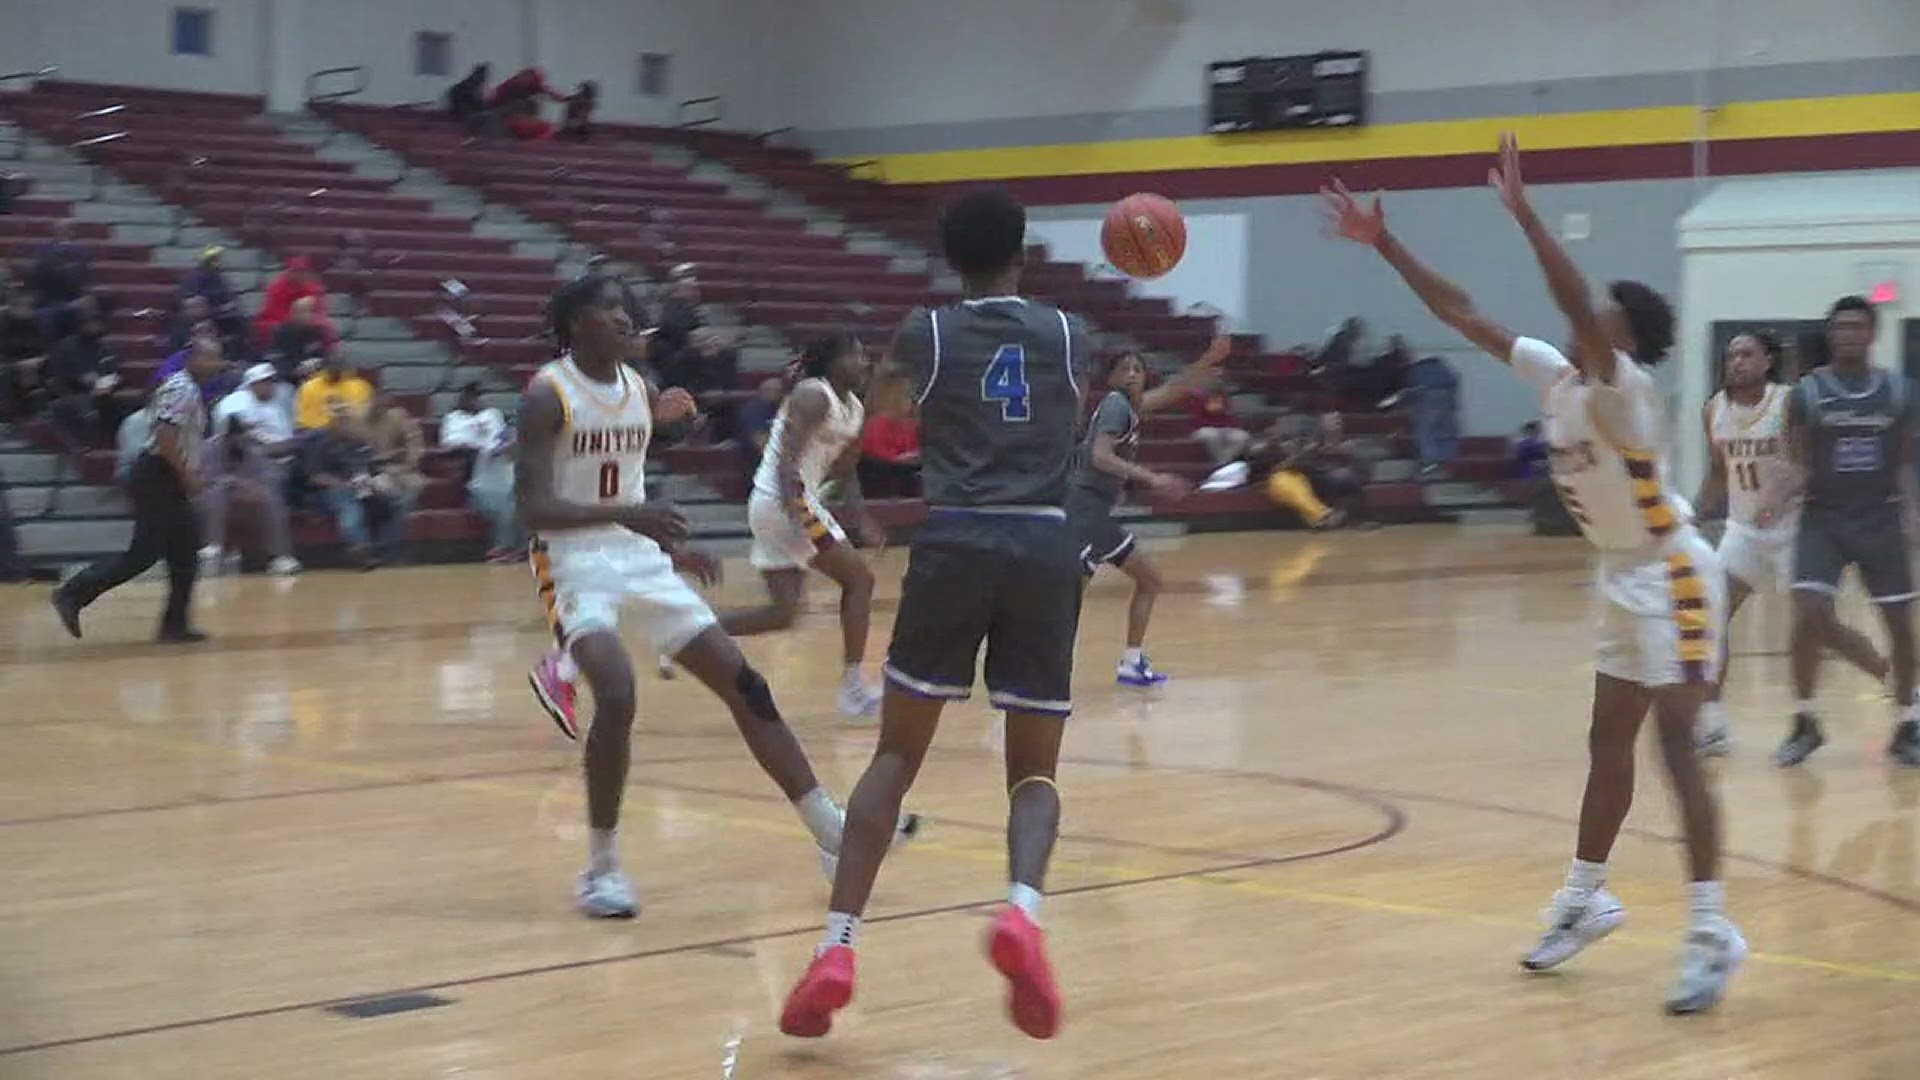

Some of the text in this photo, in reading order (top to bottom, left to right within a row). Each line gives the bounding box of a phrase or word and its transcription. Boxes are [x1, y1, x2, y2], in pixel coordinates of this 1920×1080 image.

[981, 343, 1030, 421] 4
[573, 427, 646, 456] UNITED
[600, 461, 619, 497] 0
[1736, 462, 1760, 491] 11
